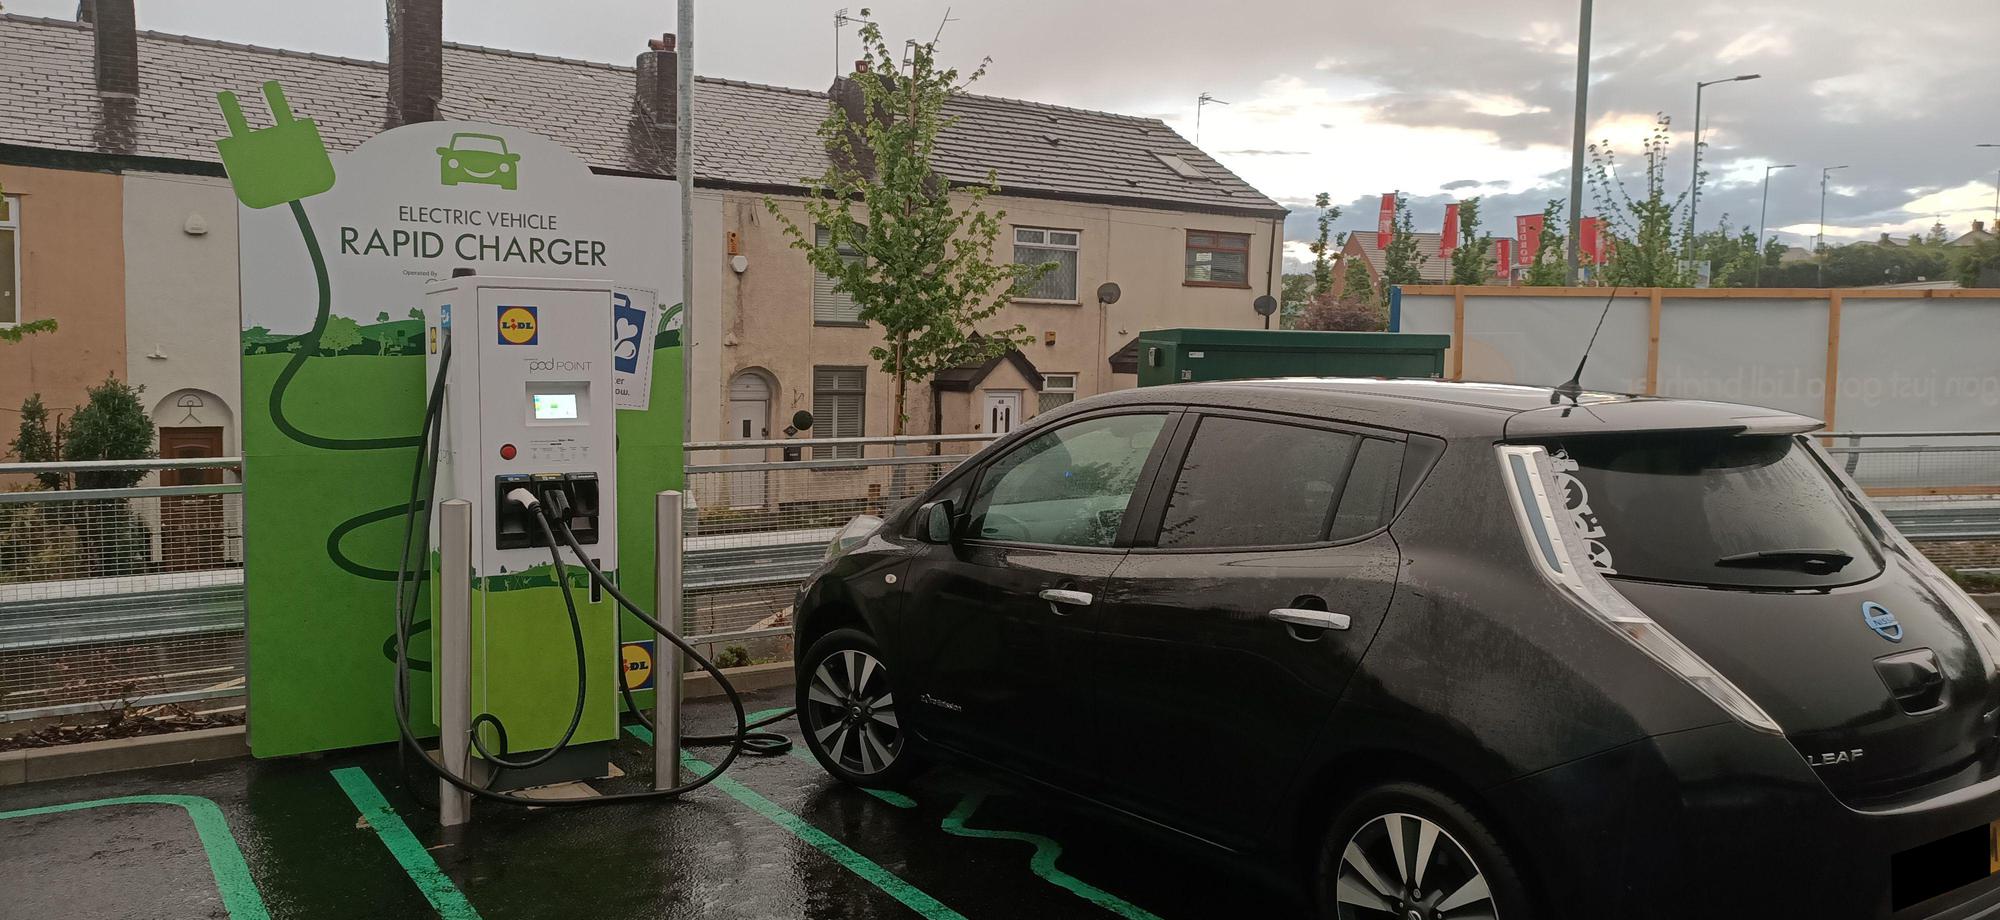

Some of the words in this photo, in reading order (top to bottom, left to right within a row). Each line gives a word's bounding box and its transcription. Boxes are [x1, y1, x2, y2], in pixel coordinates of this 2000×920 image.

[398, 205, 482, 227] ELECTRIC
[487, 210, 558, 231] VEHICLE
[340, 226, 444, 259] RAPID
[455, 233, 607, 267] CHARGER
[529, 357, 555, 374] pod
[556, 361, 593, 372] POINT
[1807, 748, 1864, 767] LEAF
